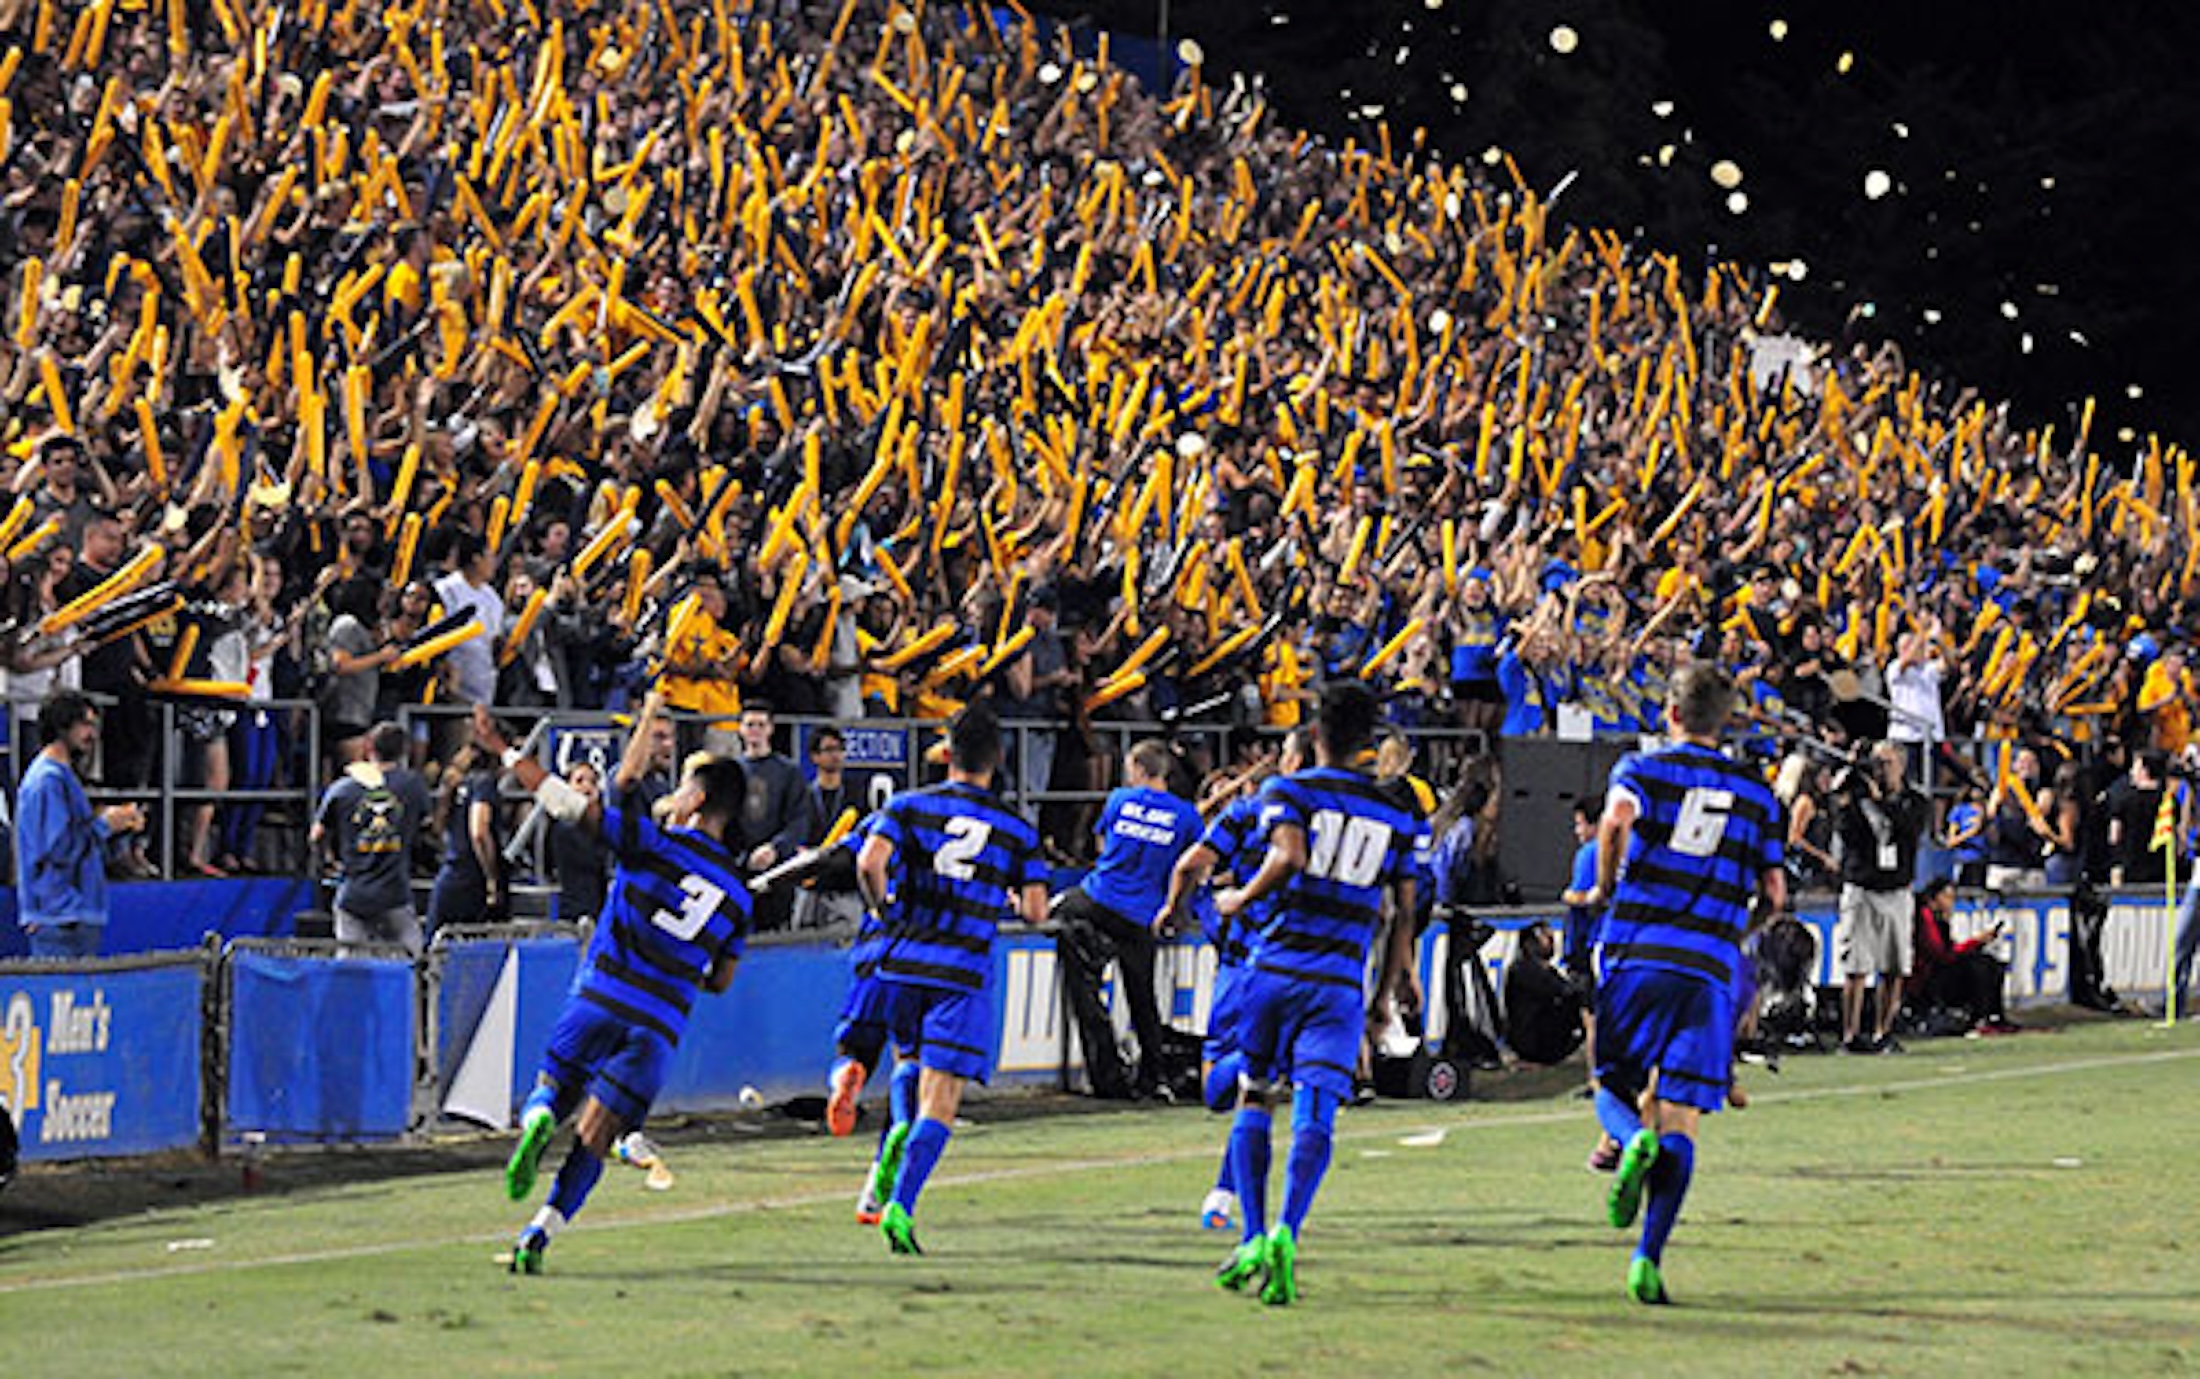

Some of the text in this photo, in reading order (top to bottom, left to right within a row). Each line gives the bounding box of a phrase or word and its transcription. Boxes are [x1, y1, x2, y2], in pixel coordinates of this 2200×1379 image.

[933, 815, 993, 882] 2
[1304, 808, 1392, 888] 10
[1667, 787, 1736, 857] 6
[651, 873, 726, 941] 3
[47, 988, 113, 1054] Men's
[41, 1077, 116, 1143] Soccer
